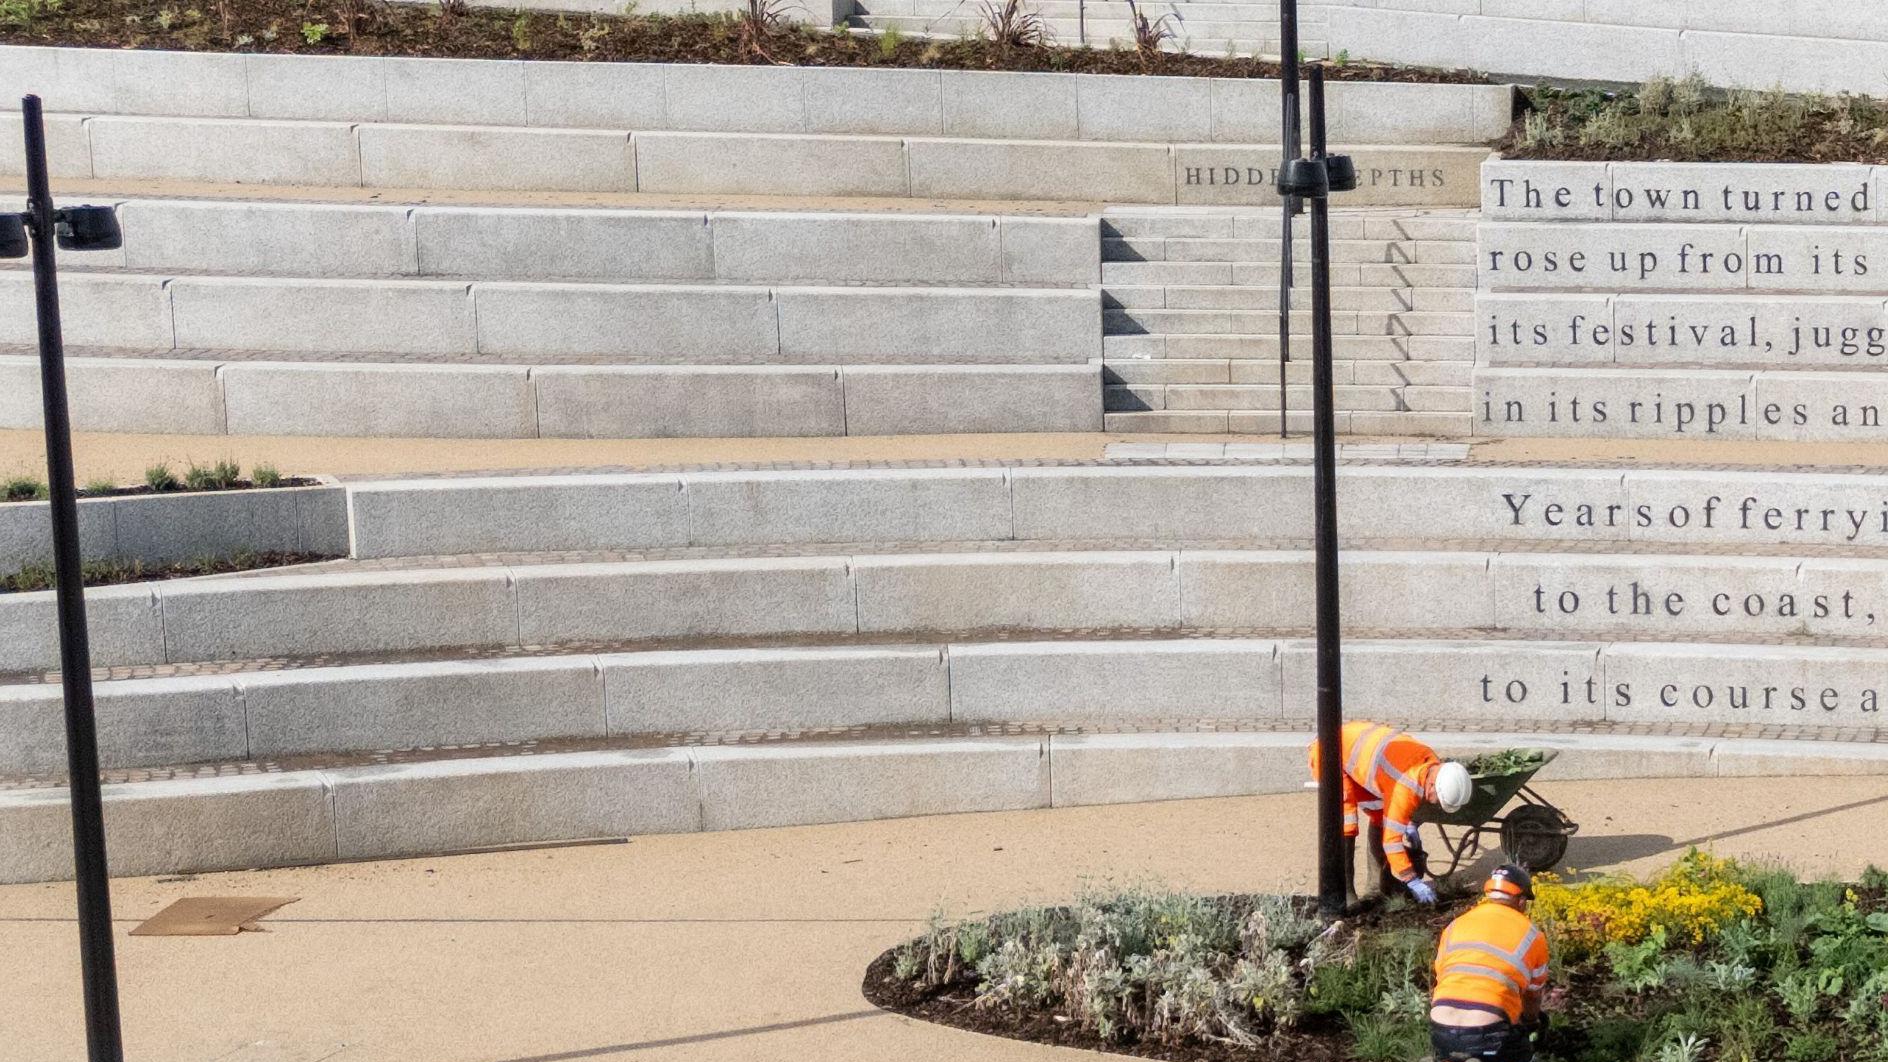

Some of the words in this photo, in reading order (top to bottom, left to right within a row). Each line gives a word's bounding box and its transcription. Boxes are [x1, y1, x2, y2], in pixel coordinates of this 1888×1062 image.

[1185, 167, 1290, 187] HIDDE
[1491, 180, 1571, 208] The
[1594, 184, 1703, 212] town
[1722, 182, 1871, 213] turned
[1488, 249, 1587, 273] rose
[1608, 252, 1657, 280] up
[1677, 244, 1785, 275] from
[1812, 249, 1867, 275] its
[1489, 315, 1547, 345] its
[1568, 314, 1775, 354] festival,
[1483, 392, 1524, 422] in
[1549, 392, 1607, 423] its
[1628, 391, 1808, 433] ripples
[1502, 494, 1652, 527] Years
[1669, 496, 1721, 528] of
[1534, 584, 1579, 613] to
[1607, 582, 1684, 616] the
[1711, 590, 1876, 624] coast,
[1480, 674, 1528, 703] to
[1560, 670, 1631, 708] its
[1660, 685, 1838, 711] course
